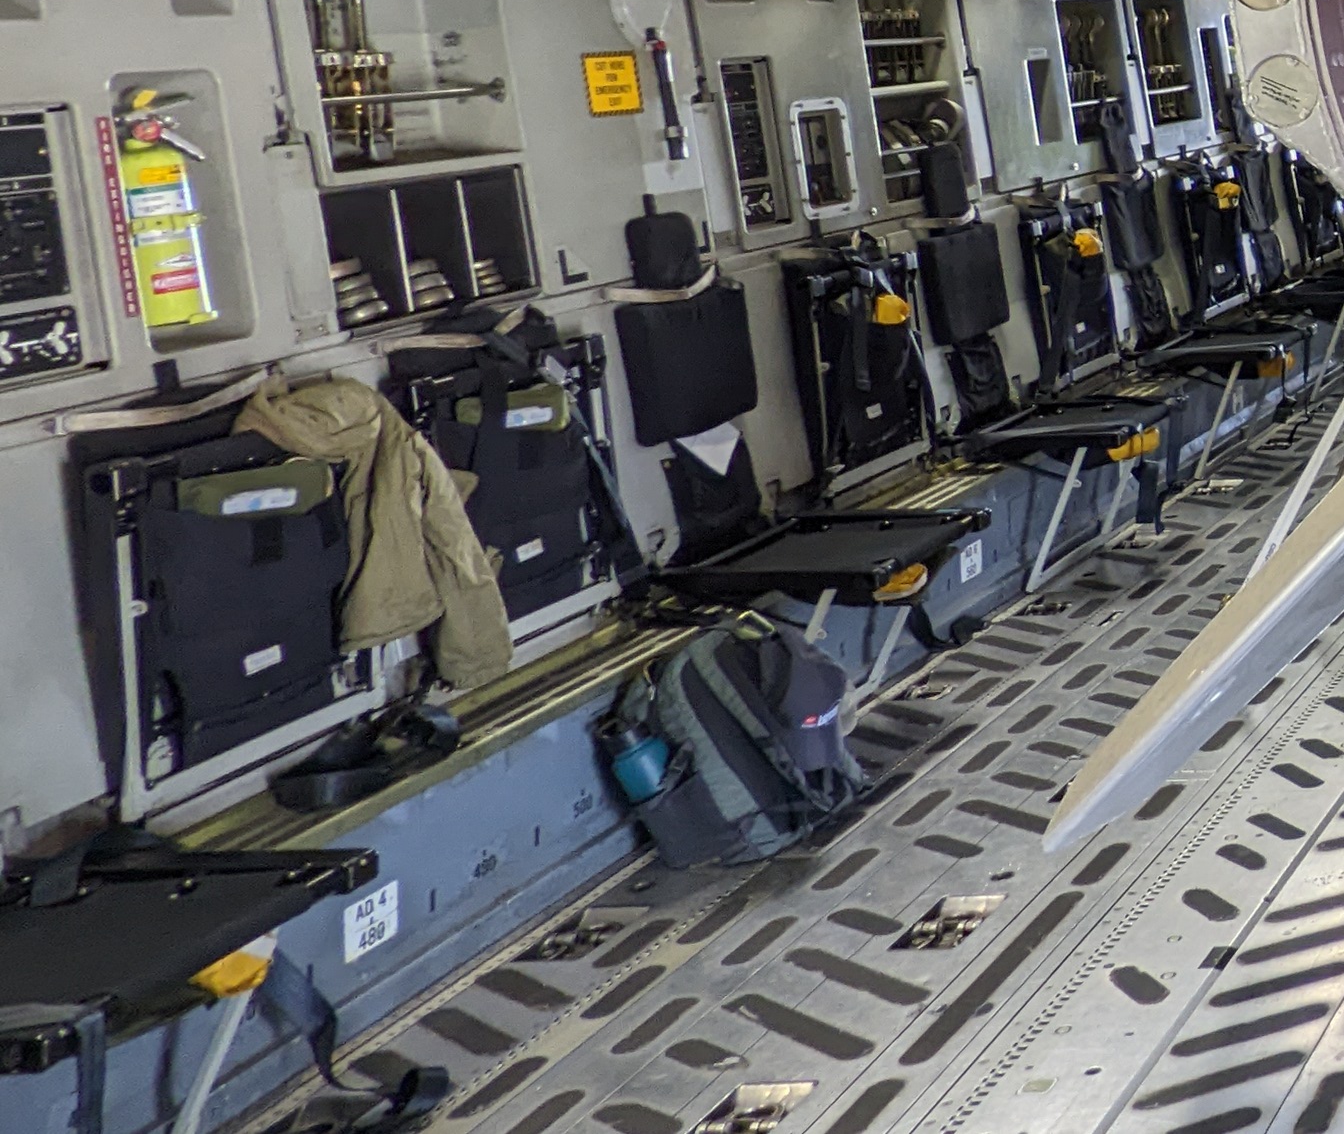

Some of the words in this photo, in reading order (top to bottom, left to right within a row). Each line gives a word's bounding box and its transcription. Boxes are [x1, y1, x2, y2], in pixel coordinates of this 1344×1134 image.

[355, 900, 374, 922] AD
[377, 889, 387, 906] 4
[357, 921, 386, 951] 480
